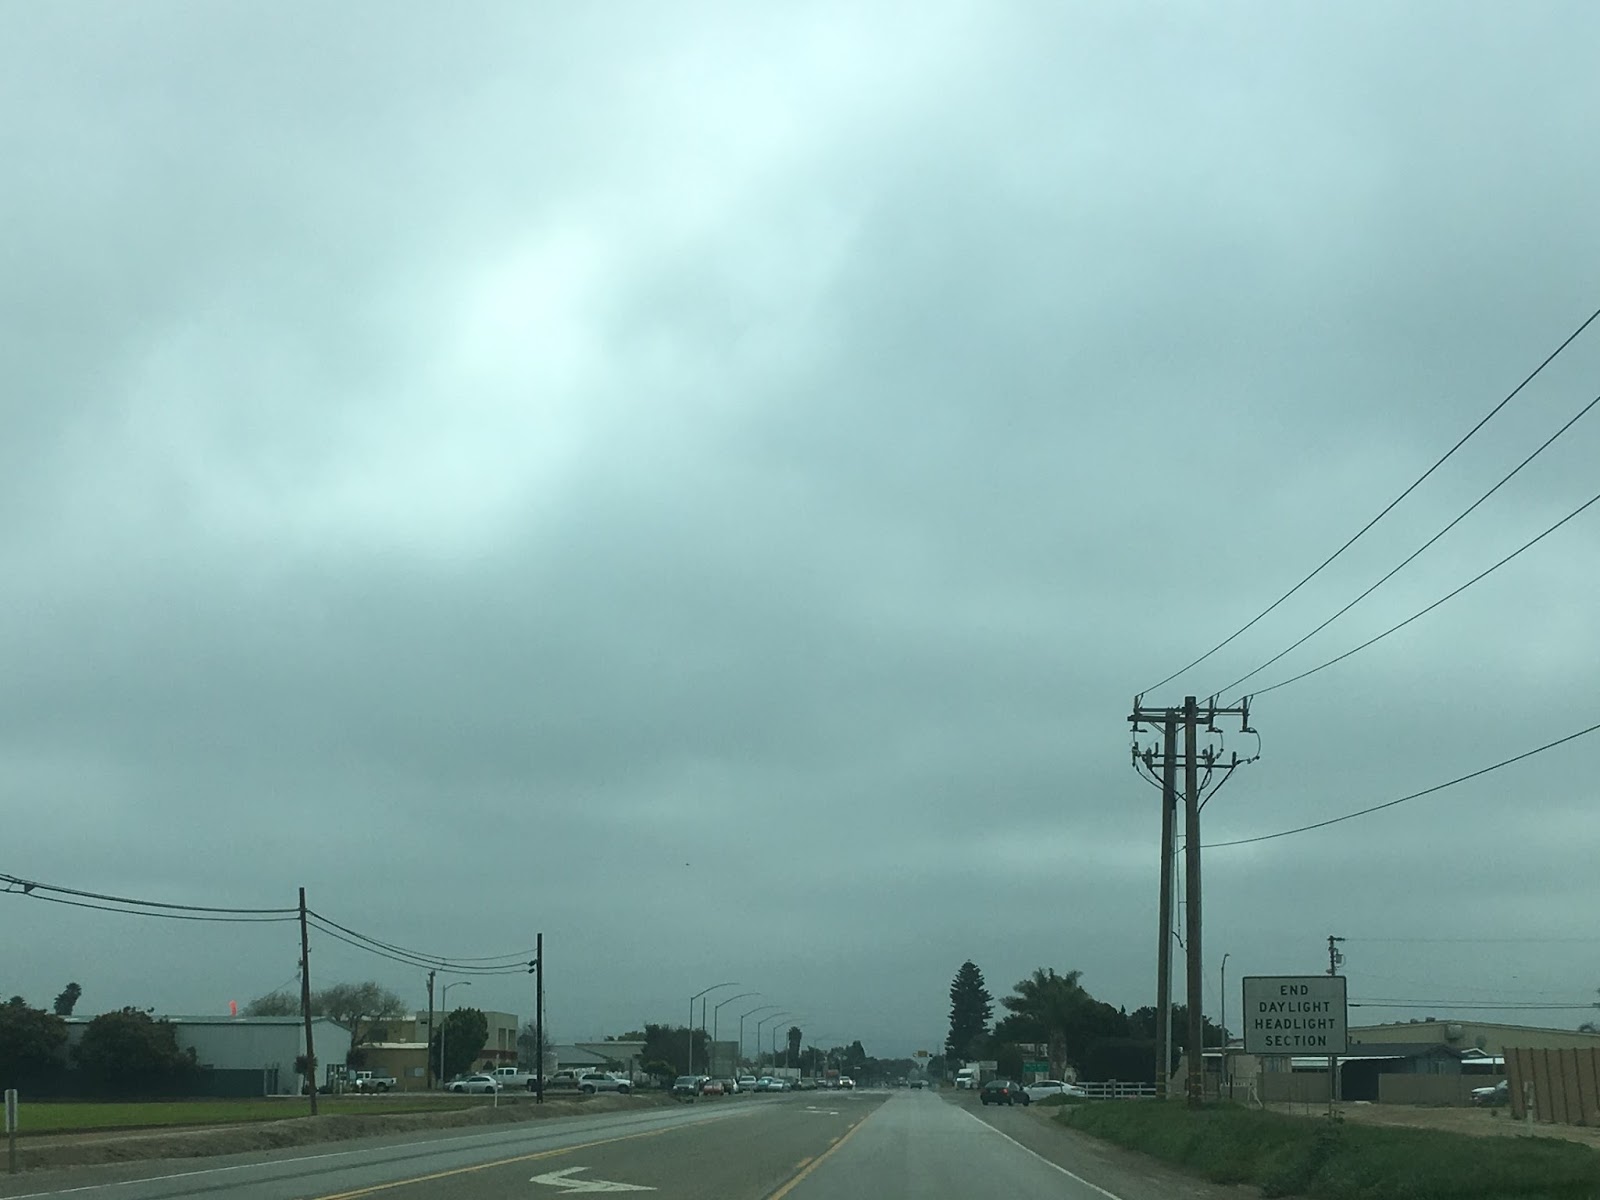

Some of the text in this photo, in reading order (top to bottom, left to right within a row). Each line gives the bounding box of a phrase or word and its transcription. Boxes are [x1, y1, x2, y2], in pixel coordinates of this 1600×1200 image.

[1280, 984, 1309, 996] END
[1259, 1001, 1330, 1013] DAYLIGHT
[1254, 1018, 1335, 1030] HEADLIGHT
[1265, 1035, 1327, 1047] SECTION
